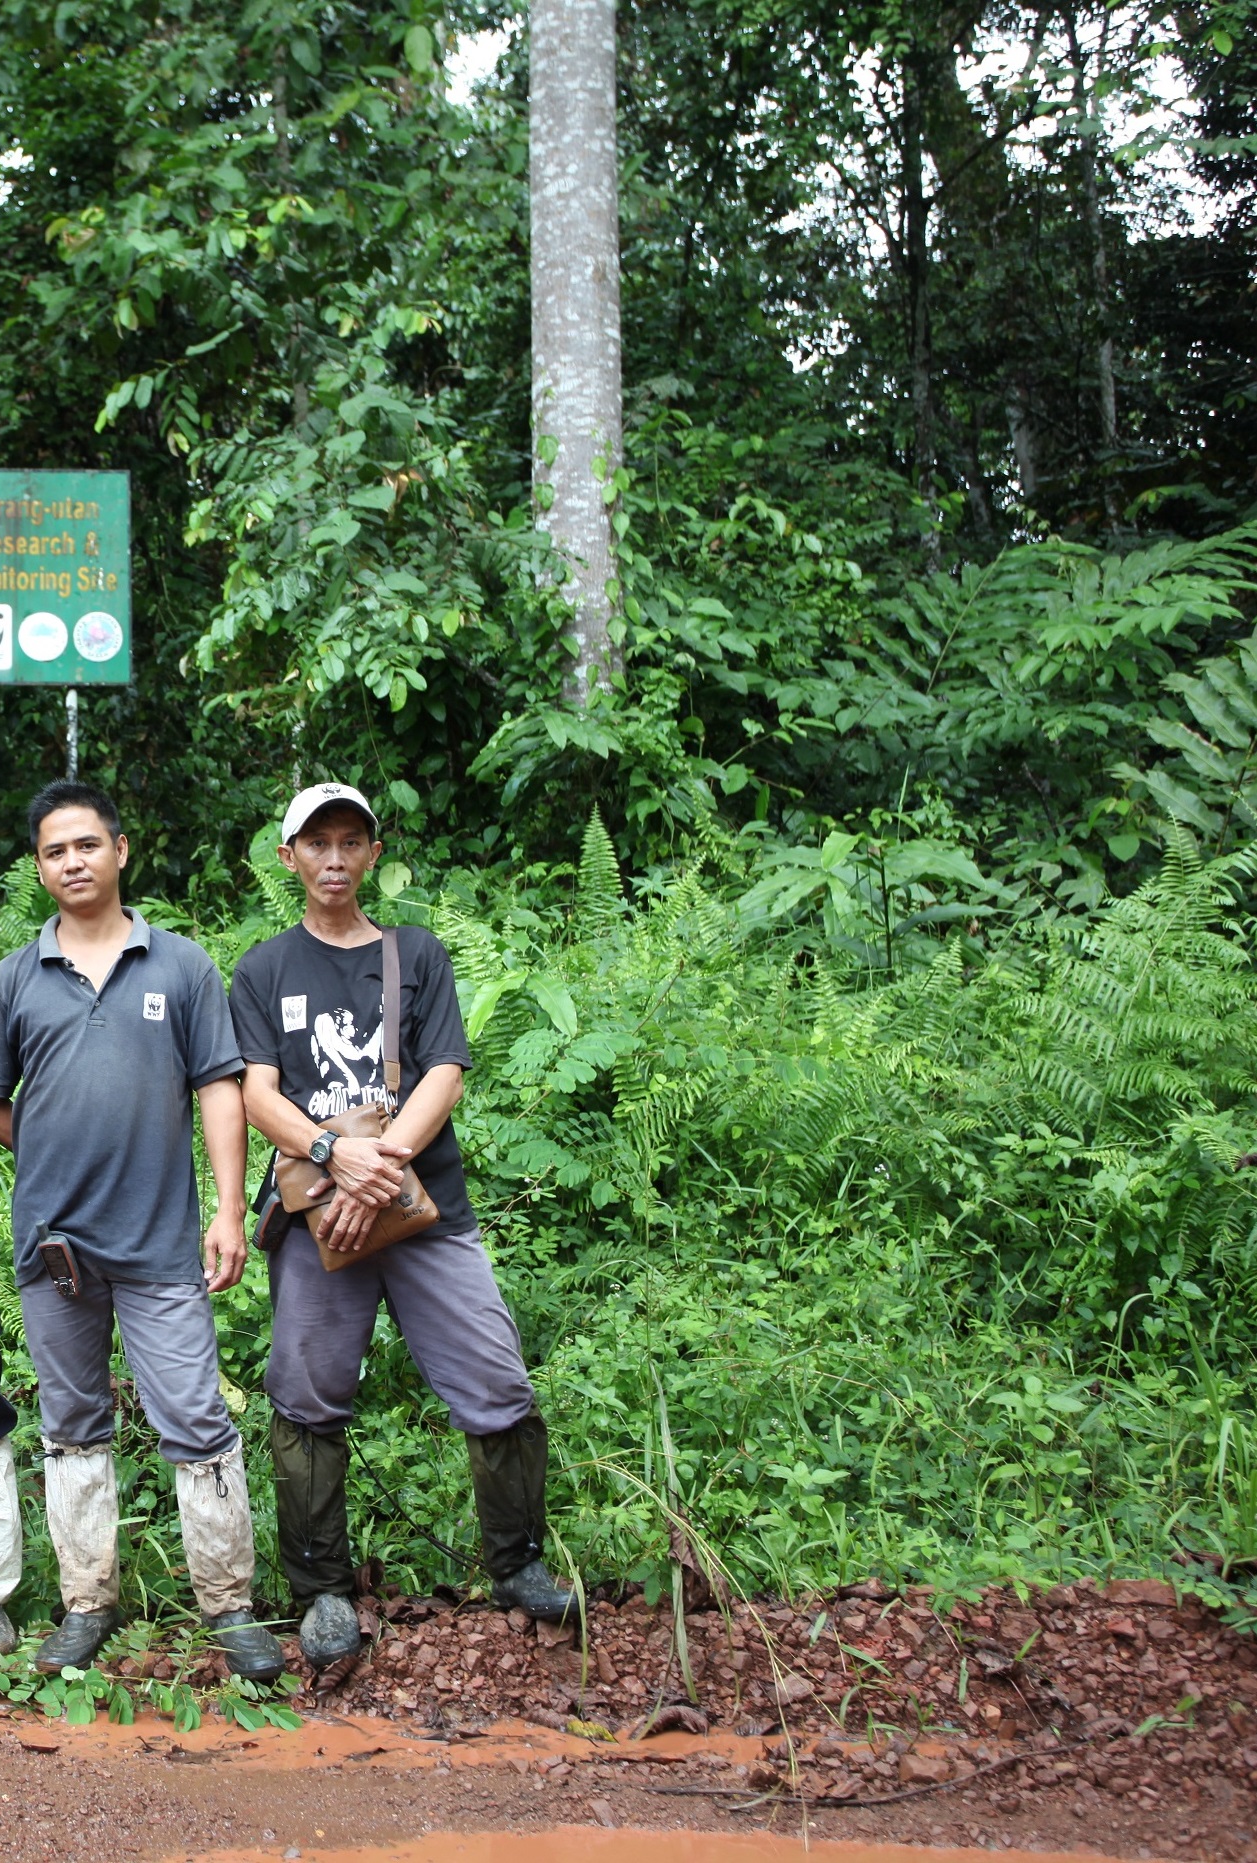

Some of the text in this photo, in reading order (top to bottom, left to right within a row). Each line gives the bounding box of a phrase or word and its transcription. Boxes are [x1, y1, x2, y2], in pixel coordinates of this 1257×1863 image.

[85, 531, 100, 556] &
[77, 566, 118, 591] Site
[400, 1205, 425, 1222] Jeep
